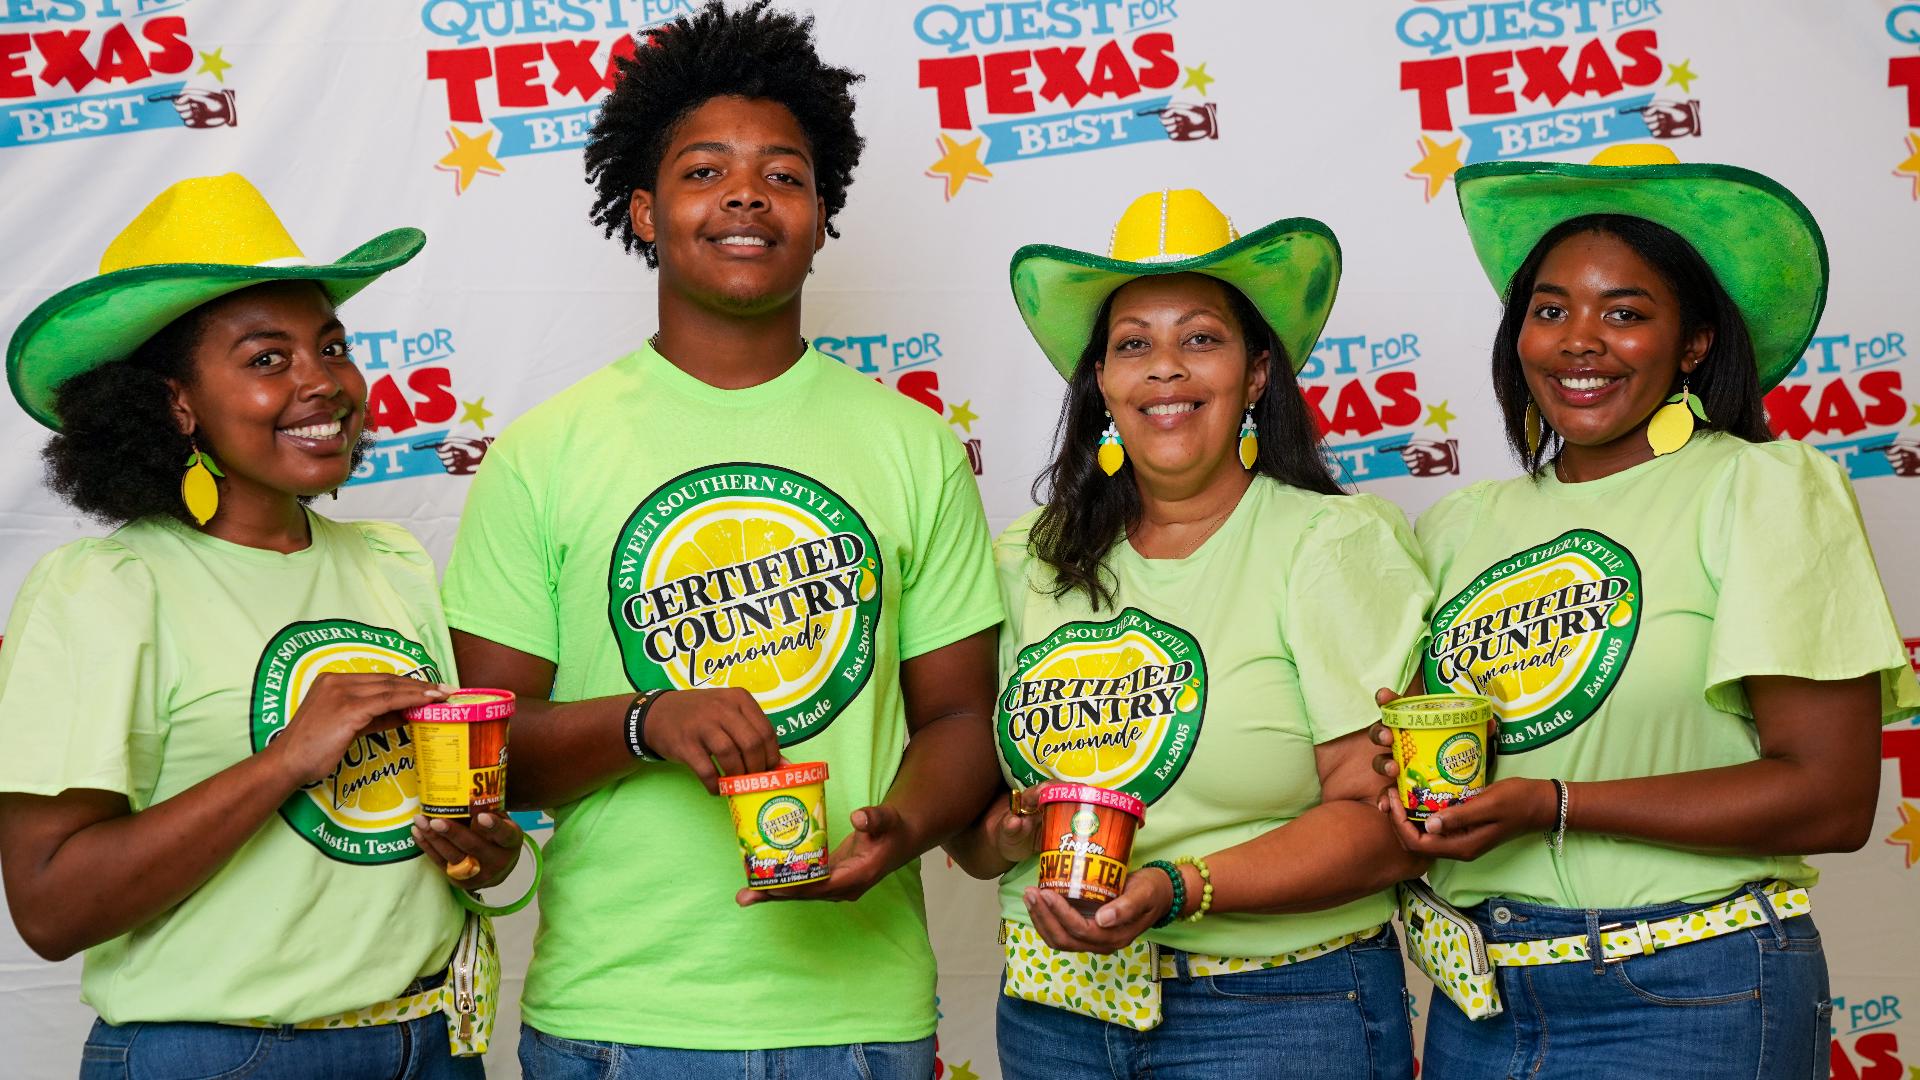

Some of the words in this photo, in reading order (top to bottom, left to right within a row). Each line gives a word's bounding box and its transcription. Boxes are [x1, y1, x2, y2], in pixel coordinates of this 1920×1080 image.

[421, 0, 629, 45] QUEST
[913, 0, 1122, 53] QUEST
[1127, 0, 1178, 27] FOR
[1396, 0, 1604, 55] QUEST
[1611, 0, 1662, 25] FOR
[0, 16, 193, 98] EXAS
[918, 33, 1180, 131] TEXAS
[1400, 30, 1663, 132] TEXAS
[9, 94, 145, 142] BEST
[524, 108, 602, 150] BE
[1012, 110, 1134, 156] BEST
[1493, 108, 1616, 156] BEST
[402, 328, 455, 363] FOR
[892, 332, 943, 367] FOR
[1370, 333, 1421, 368] FOR
[1855, 332, 1907, 366] FOR
[1762, 370, 1907, 441] XAS
[618, 512, 660, 590] SWEET
[656, 474, 777, 517] SOUTHERN
[780, 480, 846, 527] STYLE
[623, 533, 865, 630] CERTIFIED
[1436, 576, 1488, 629] SWEET
[1491, 536, 1583, 579] SOUTHERN
[1581, 540, 1625, 573] STYLE
[644, 569, 860, 663] COUNTRY
[1018, 634, 1062, 669] WEET
[1065, 614, 1156, 639] SOUTHERN
[1151, 628, 1190, 659] STYLE
[1429, 577, 1630, 660] CERTIFIED
[688, 613, 827, 687] Lemonade
[841, 614, 870, 683] Est.2005
[1437, 602, 1616, 684] COUNTRY
[1583, 637, 1623, 699] Est.2005
[262, 657, 287, 725] SWEET
[278, 627, 359, 661] SOUTHERN
[361, 630, 422, 660] STYLE
[1004, 661, 1194, 712] CERTIFIED
[629, 706, 642, 744] BRAKES.
[786, 698, 832, 735] Made
[1008, 685, 1182, 742] COUNTRY
[1407, 710, 1478, 726] JALAPENO
[1524, 708, 1575, 741] Made
[1033, 717, 1143, 765] Lemonade
[1153, 722, 1191, 781] Est.2005
[333, 755, 415, 811] Lemona
[733, 774, 781, 793] BUBBA
[784, 767, 823, 785] PEACH
[311, 821, 362, 855] Austin
[364, 836, 416, 856] Texas
[1058, 833, 1106, 858] Frozen
[1099, 860, 1123, 888] TEA
[1850, 995, 1903, 1029] FOR
